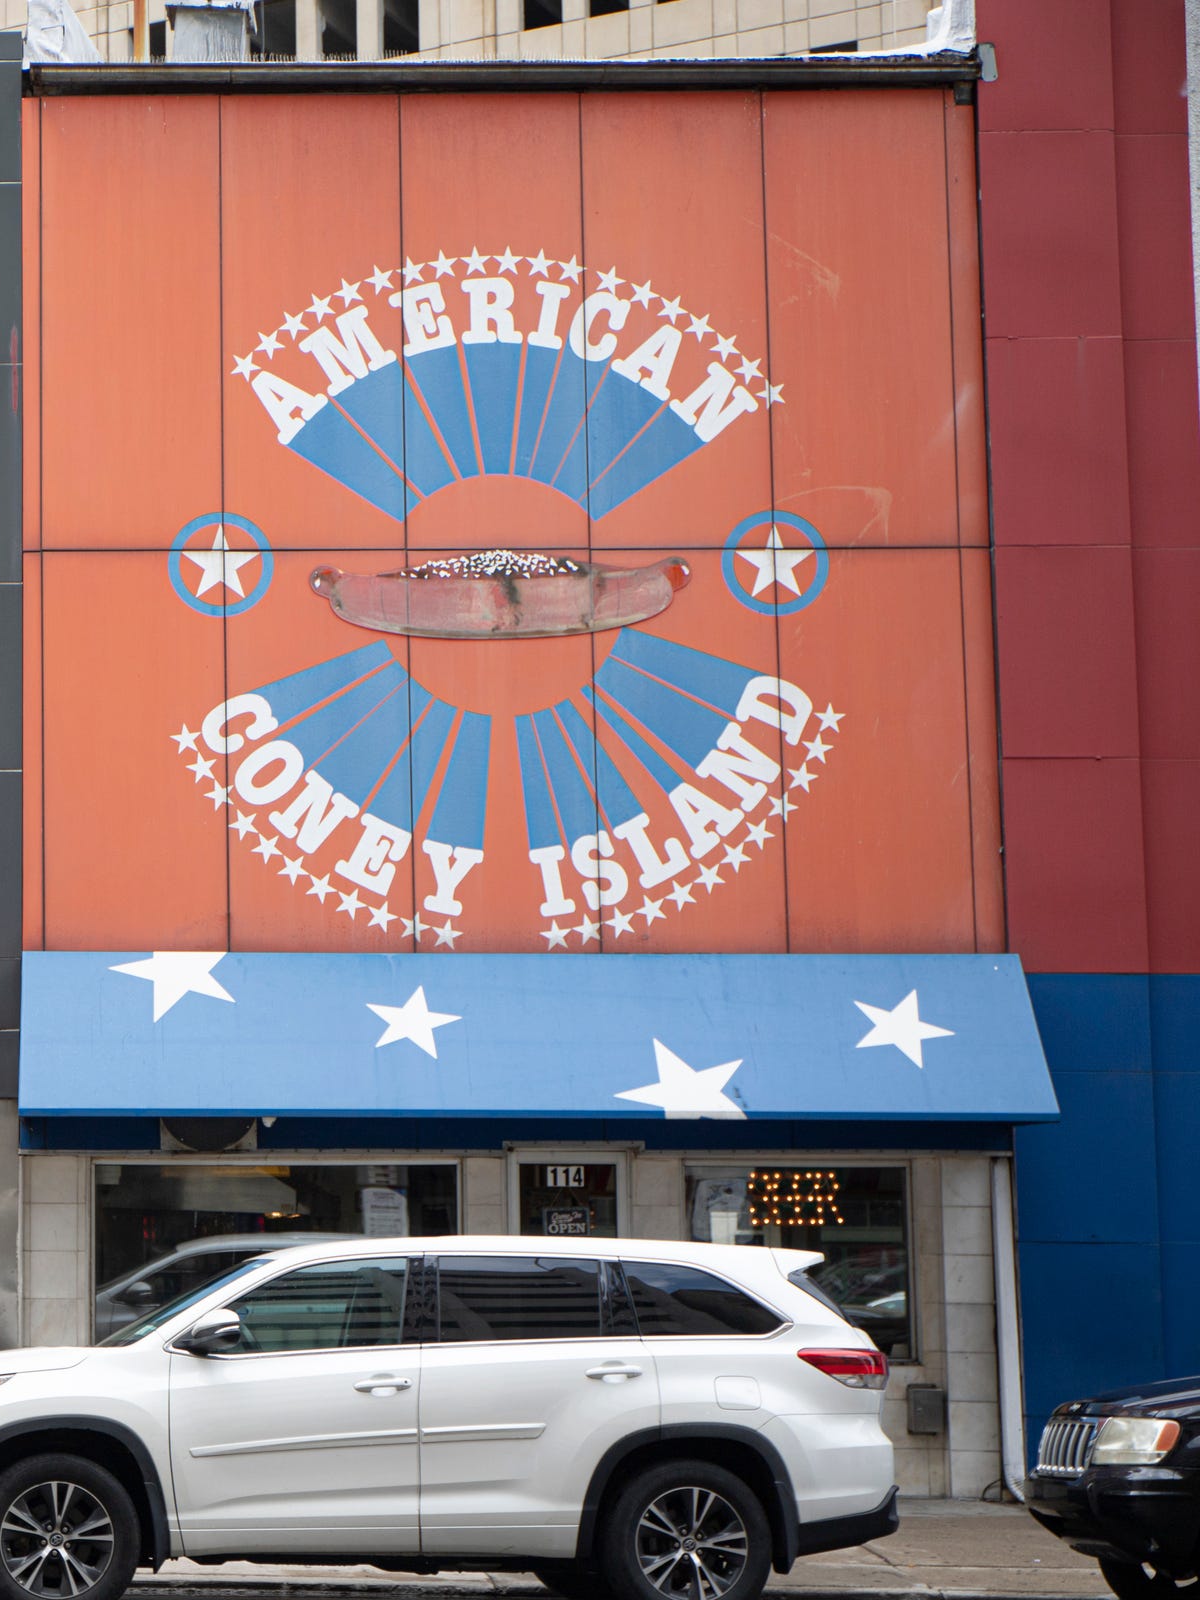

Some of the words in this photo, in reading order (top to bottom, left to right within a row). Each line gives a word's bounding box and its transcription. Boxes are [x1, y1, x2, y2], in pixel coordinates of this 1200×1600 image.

[251, 276, 759, 445] AMERICAN
[201, 693, 484, 918] CONEY
[528, 675, 814, 919] ISLAND
[550, 1167, 583, 1186] 114
[548, 1222, 586, 1234] OPEN
